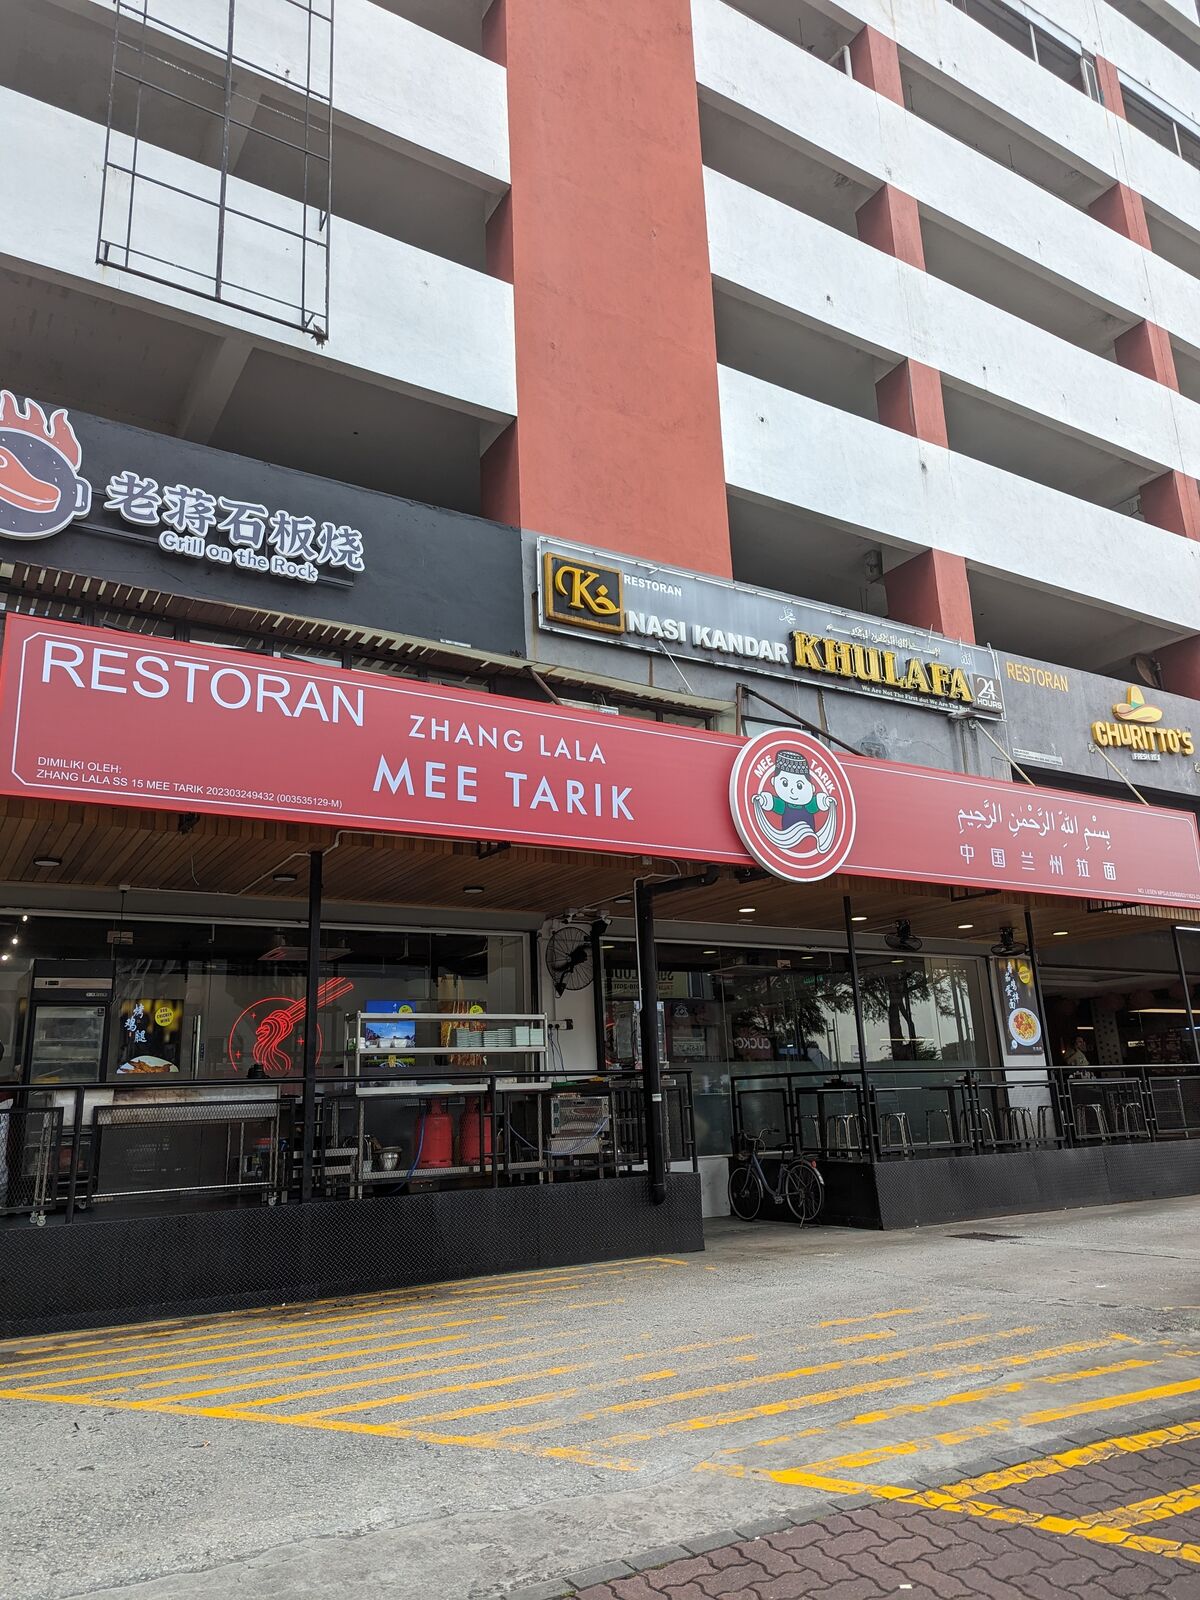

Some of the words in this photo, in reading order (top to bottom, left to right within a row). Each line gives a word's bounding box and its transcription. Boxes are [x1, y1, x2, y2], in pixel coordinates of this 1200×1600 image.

[104, 471, 365, 571] 老蒋石板烧
[159, 531, 205, 558] Grill
[206, 544, 232, 565] on
[235, 549, 269, 572] the
[270, 557, 318, 583] Rock
[623, 574, 682, 598] RESTORAN
[626, 610, 687, 644] NASI
[692, 624, 790, 665] KANDAR
[790, 630, 976, 703] KHULAFA
[42, 640, 364, 727] RESTORAN
[976, 677, 1000, 700] 24
[1006, 661, 1069, 693] RESTORAN
[977, 697, 1003, 710] HOURS
[408, 714, 524, 752] ZHANG
[539, 734, 606, 765] LALA
[1091, 721, 1195, 757] CHURITTO'S
[36, 769, 79, 782] ZHANG
[82, 773, 110, 785] LALA
[112, 777, 128, 787] SS
[132, 779, 144, 788] 15
[146, 780, 170, 791] MEE
[172, 782, 204, 794] TARIK
[37, 756, 84, 770] DIMILIKI
[87, 761, 122, 774] OLEH:
[753, 754, 774, 779] MEE
[810, 759, 836, 794] TARIK
[372, 754, 477, 803] MEE
[504, 771, 635, 821] TARIK
[960, 843, 1117, 881] 中国兰州拉面
